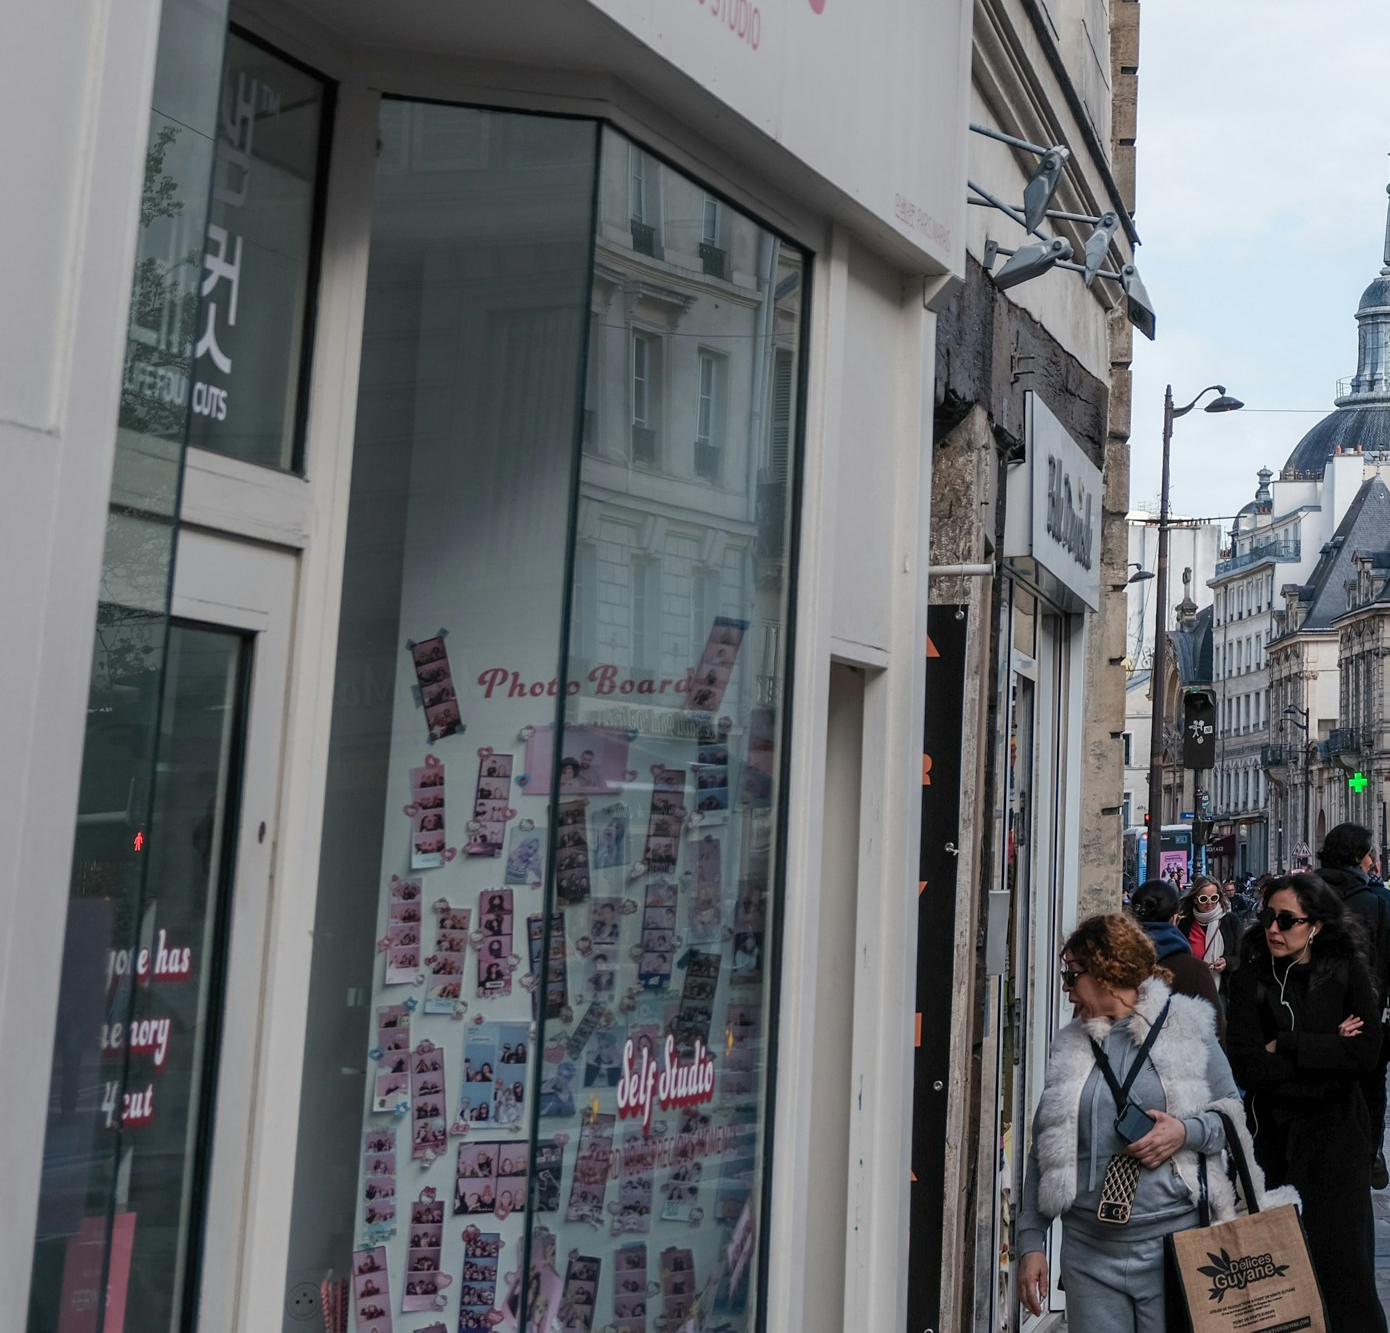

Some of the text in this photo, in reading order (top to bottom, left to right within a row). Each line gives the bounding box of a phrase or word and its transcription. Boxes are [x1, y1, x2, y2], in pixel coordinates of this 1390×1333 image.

[192, 381, 227, 421] CUTS
[477, 663, 698, 701] Photo Board
[155, 929, 191, 976] has
[617, 1034, 714, 1126] Self Studio
[1214, 1264, 1275, 1289] Guyane
[1230, 1253, 1272, 1273] Délices
